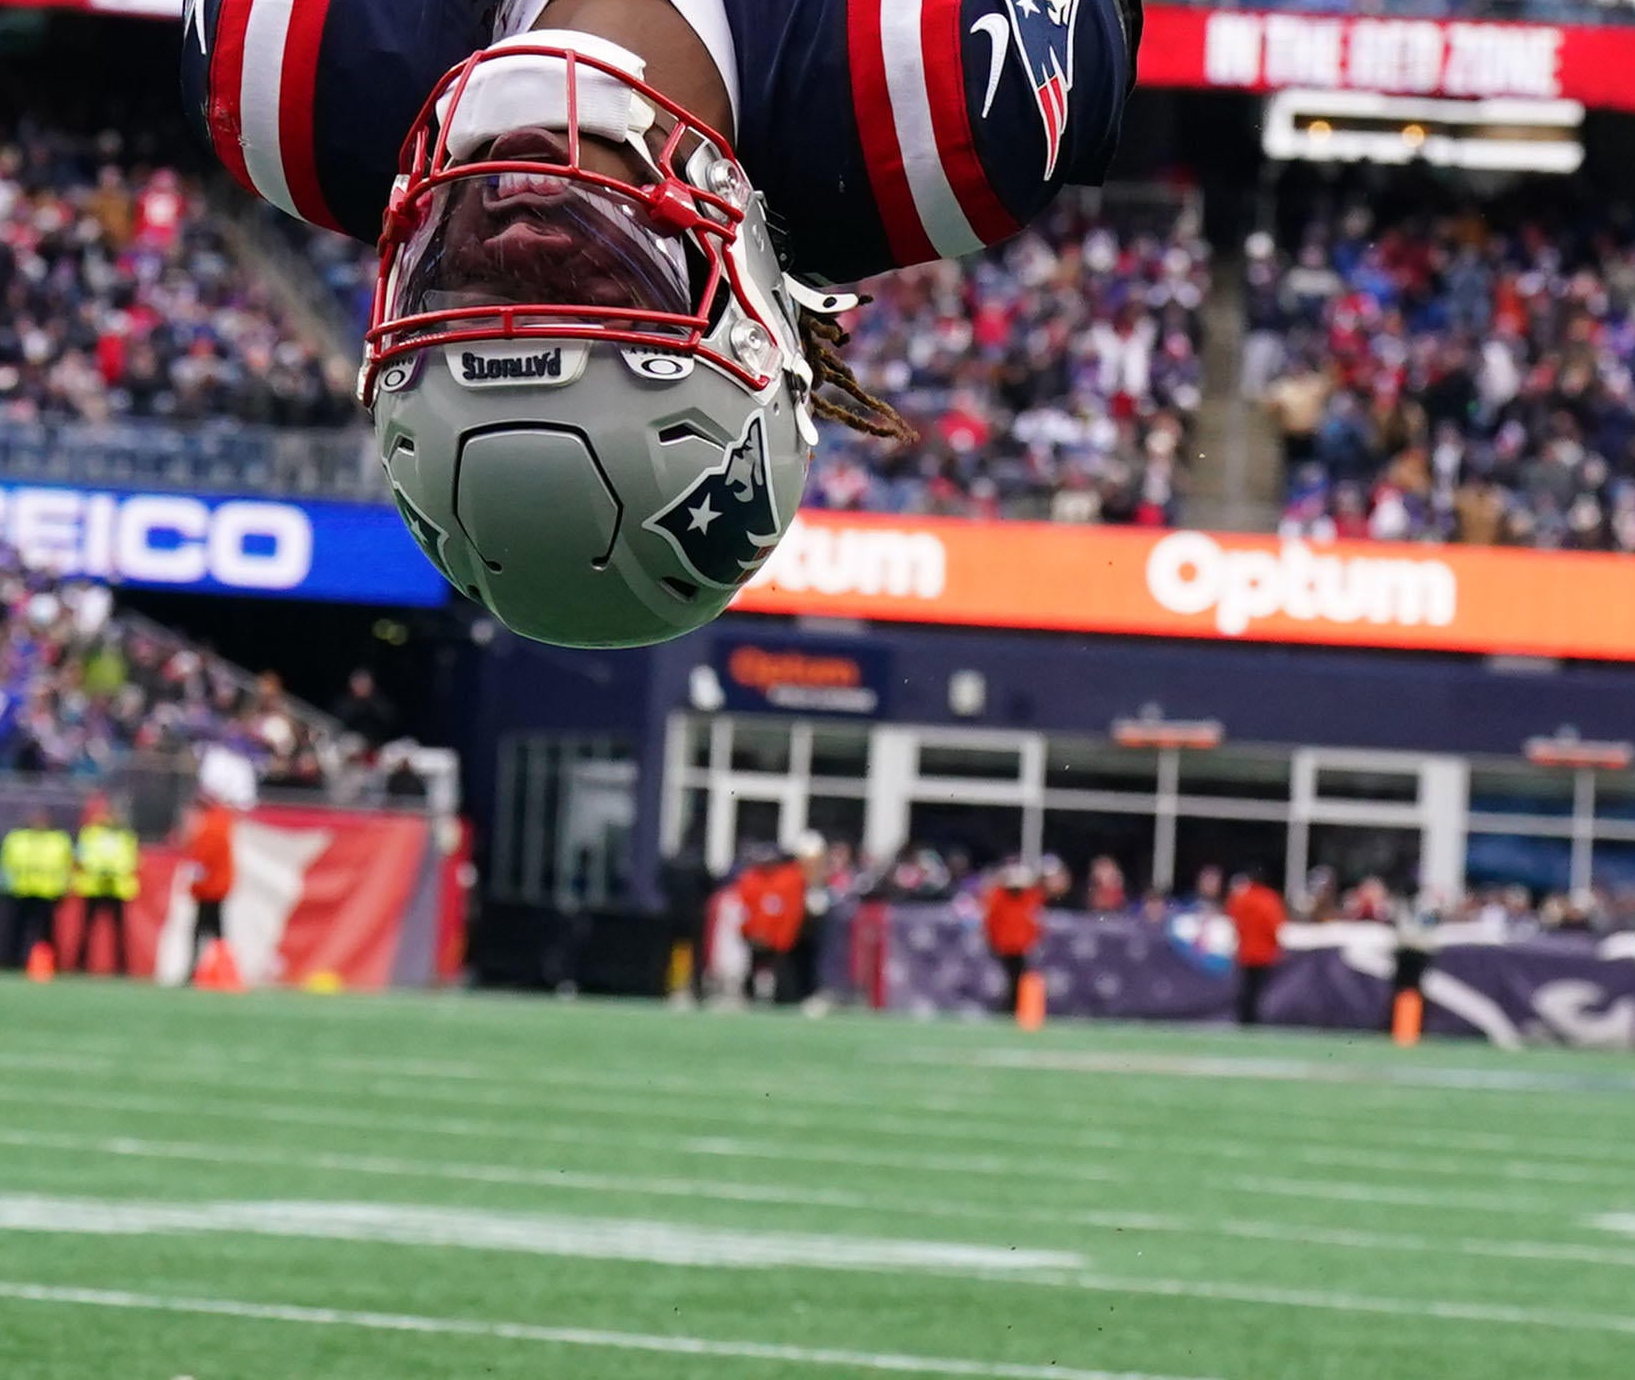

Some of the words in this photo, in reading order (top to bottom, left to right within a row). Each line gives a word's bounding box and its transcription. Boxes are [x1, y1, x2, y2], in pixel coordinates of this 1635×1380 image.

[1205, 12, 1261, 85] IN
[1263, 14, 1341, 87] THE
[1347, 17, 1444, 91] RED
[1442, 22, 1560, 96] ZONE
[461, 347, 562, 380] PATRIOTS
[1146, 530, 1457, 636] Optum
